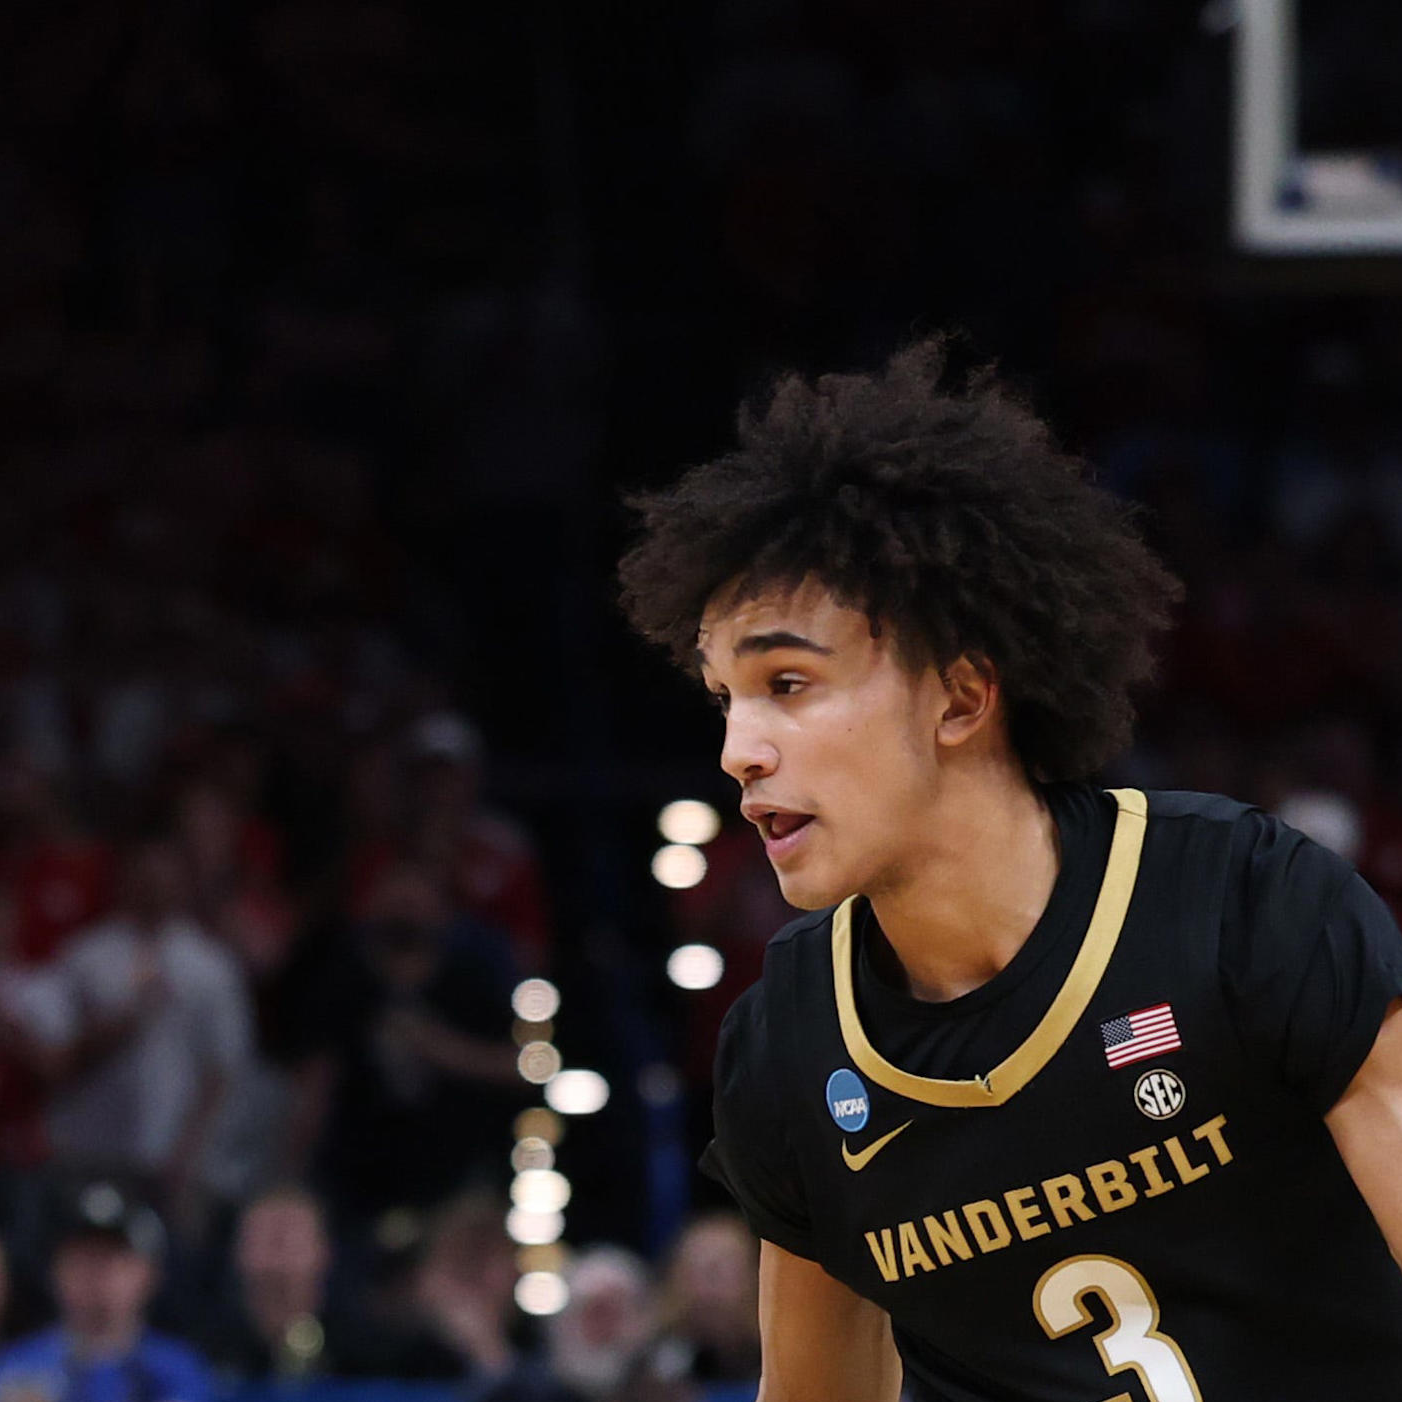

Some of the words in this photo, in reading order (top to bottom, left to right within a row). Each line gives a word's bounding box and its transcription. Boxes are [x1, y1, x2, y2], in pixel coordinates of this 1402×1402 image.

[833, 1097, 867, 1118] NCAA
[1138, 1073, 1182, 1116] SEC
[864, 1114, 1235, 1282] VANDERBILT
